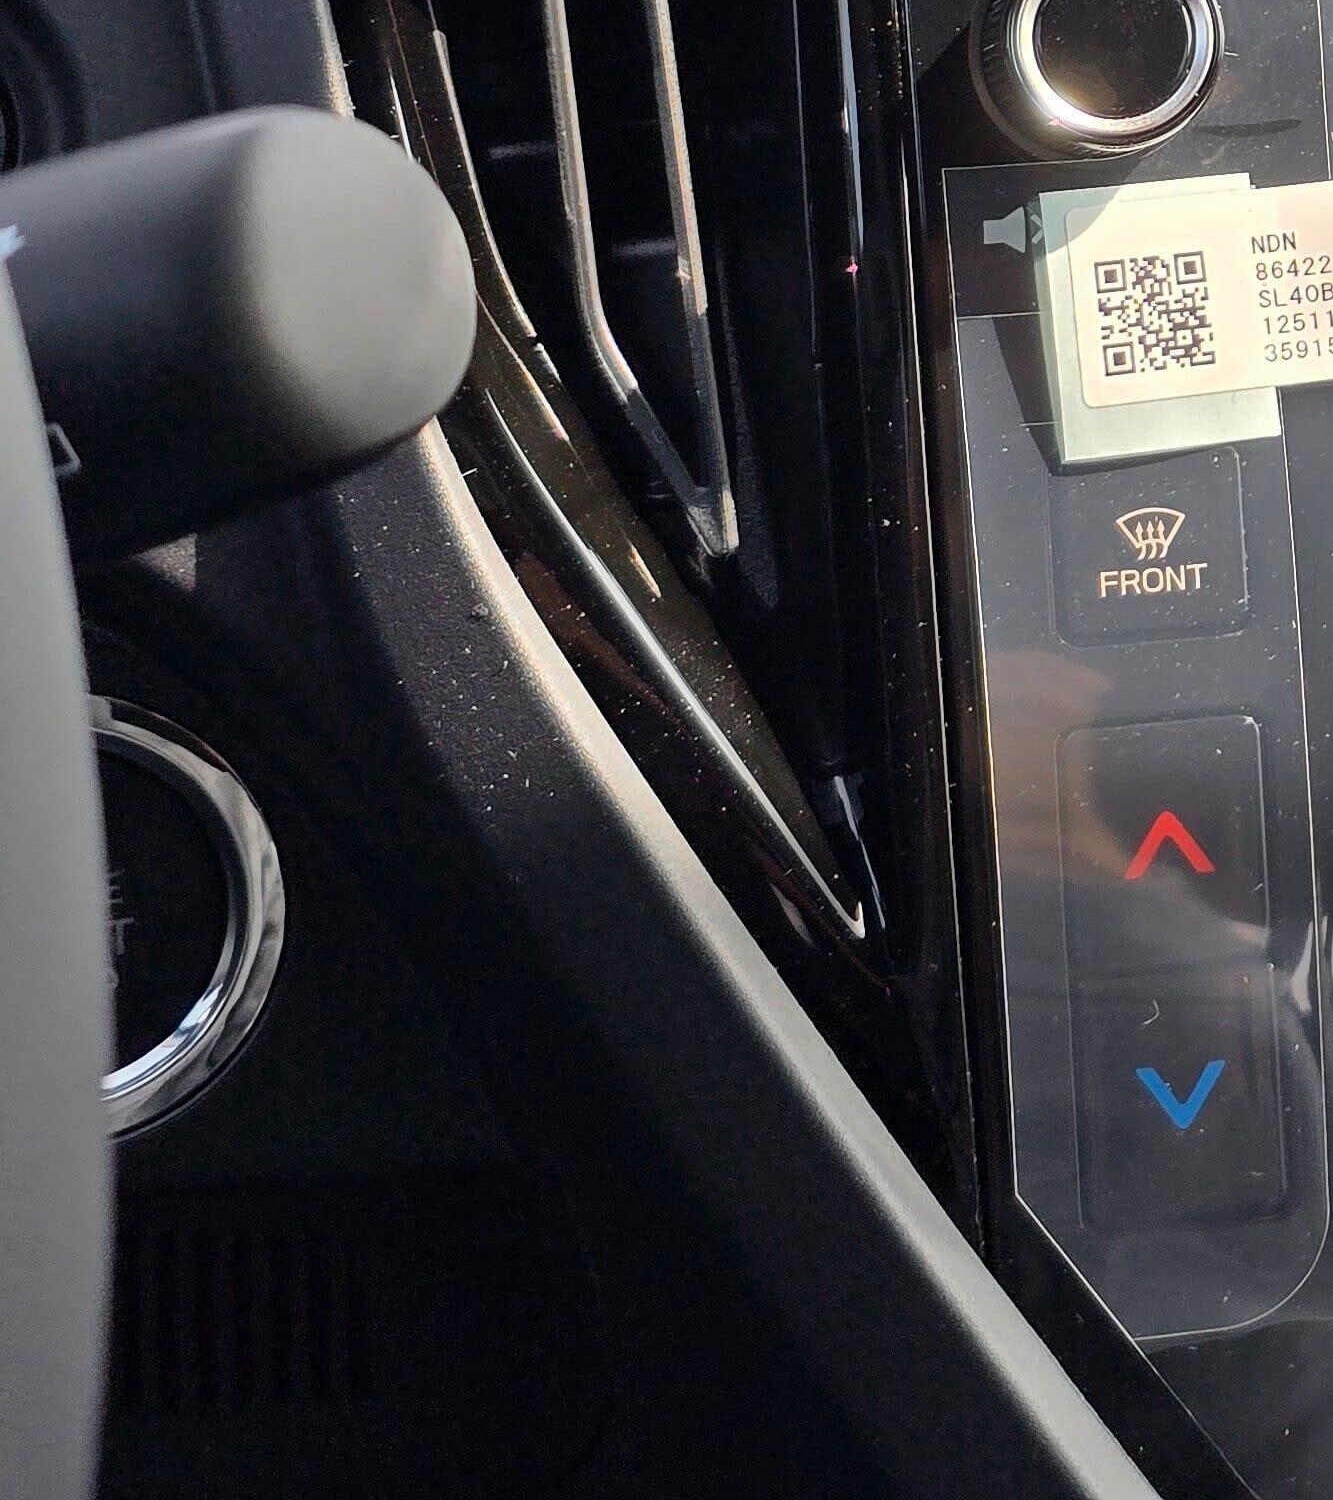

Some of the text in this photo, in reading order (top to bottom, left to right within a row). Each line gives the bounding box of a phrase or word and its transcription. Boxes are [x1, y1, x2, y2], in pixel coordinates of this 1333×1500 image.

[1251, 231, 1298, 255] NDN
[1255, 255, 1333, 282] 86422
[1100, 562, 1209, 599] FRONT
